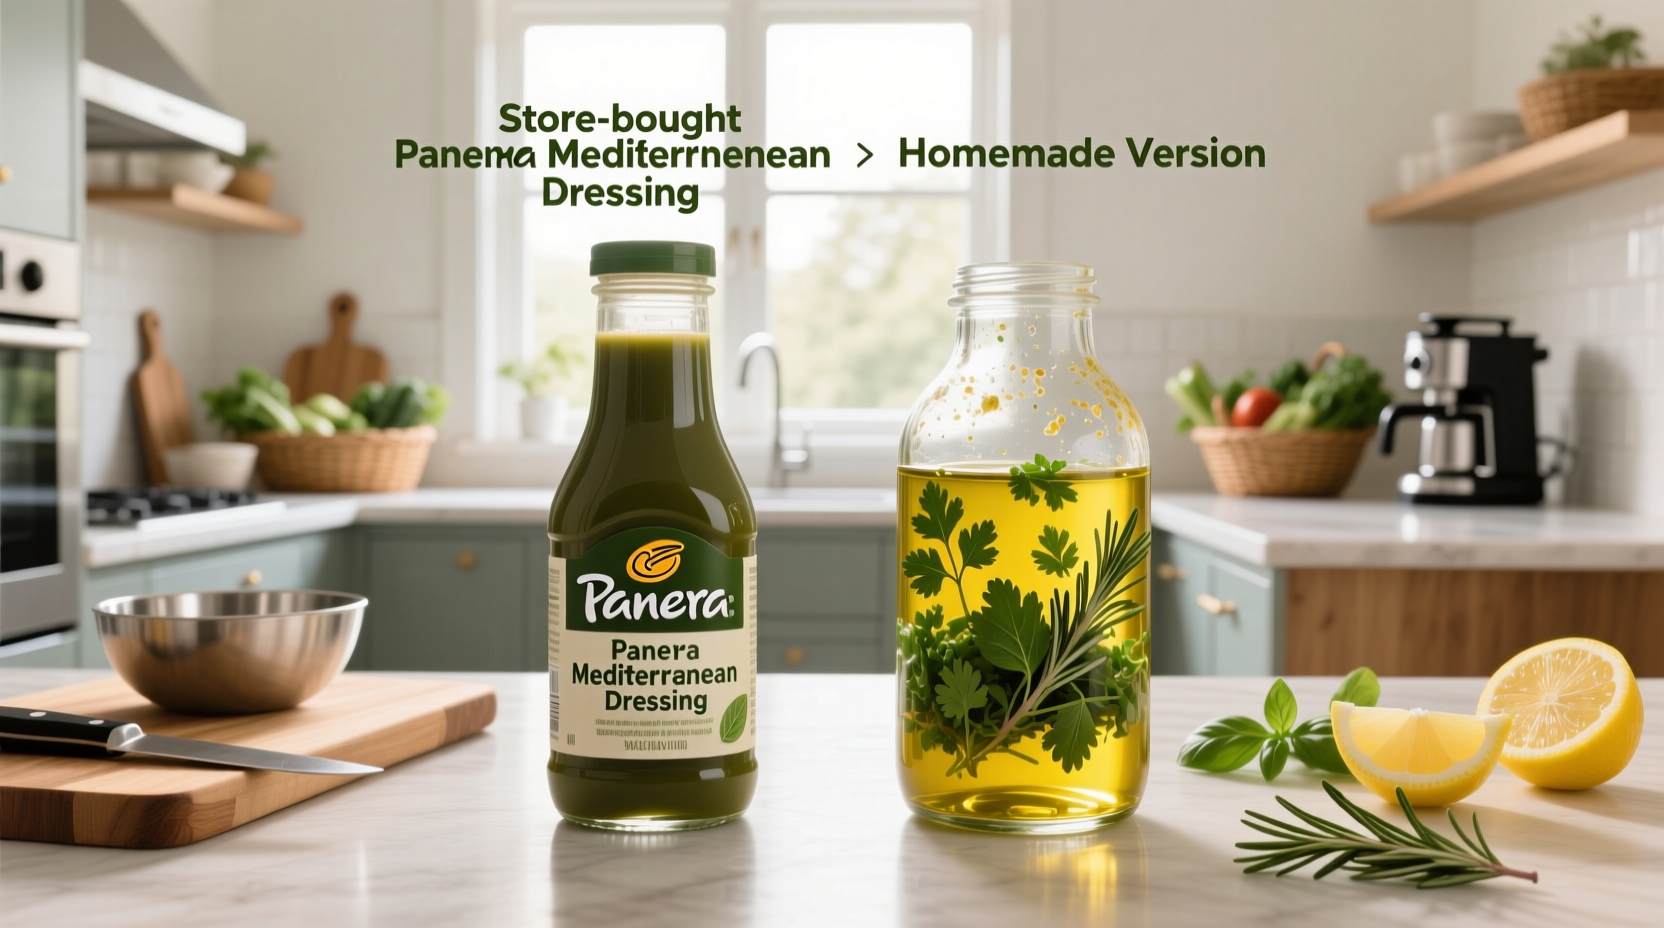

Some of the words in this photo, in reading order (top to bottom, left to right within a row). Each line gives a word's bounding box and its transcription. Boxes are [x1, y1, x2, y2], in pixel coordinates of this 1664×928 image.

[576, 573, 729, 623] Panera
[611, 638, 700, 661] Panera
[571, 662, 738, 686] Mediterranean
[605, 689, 709, 716] Dressing
